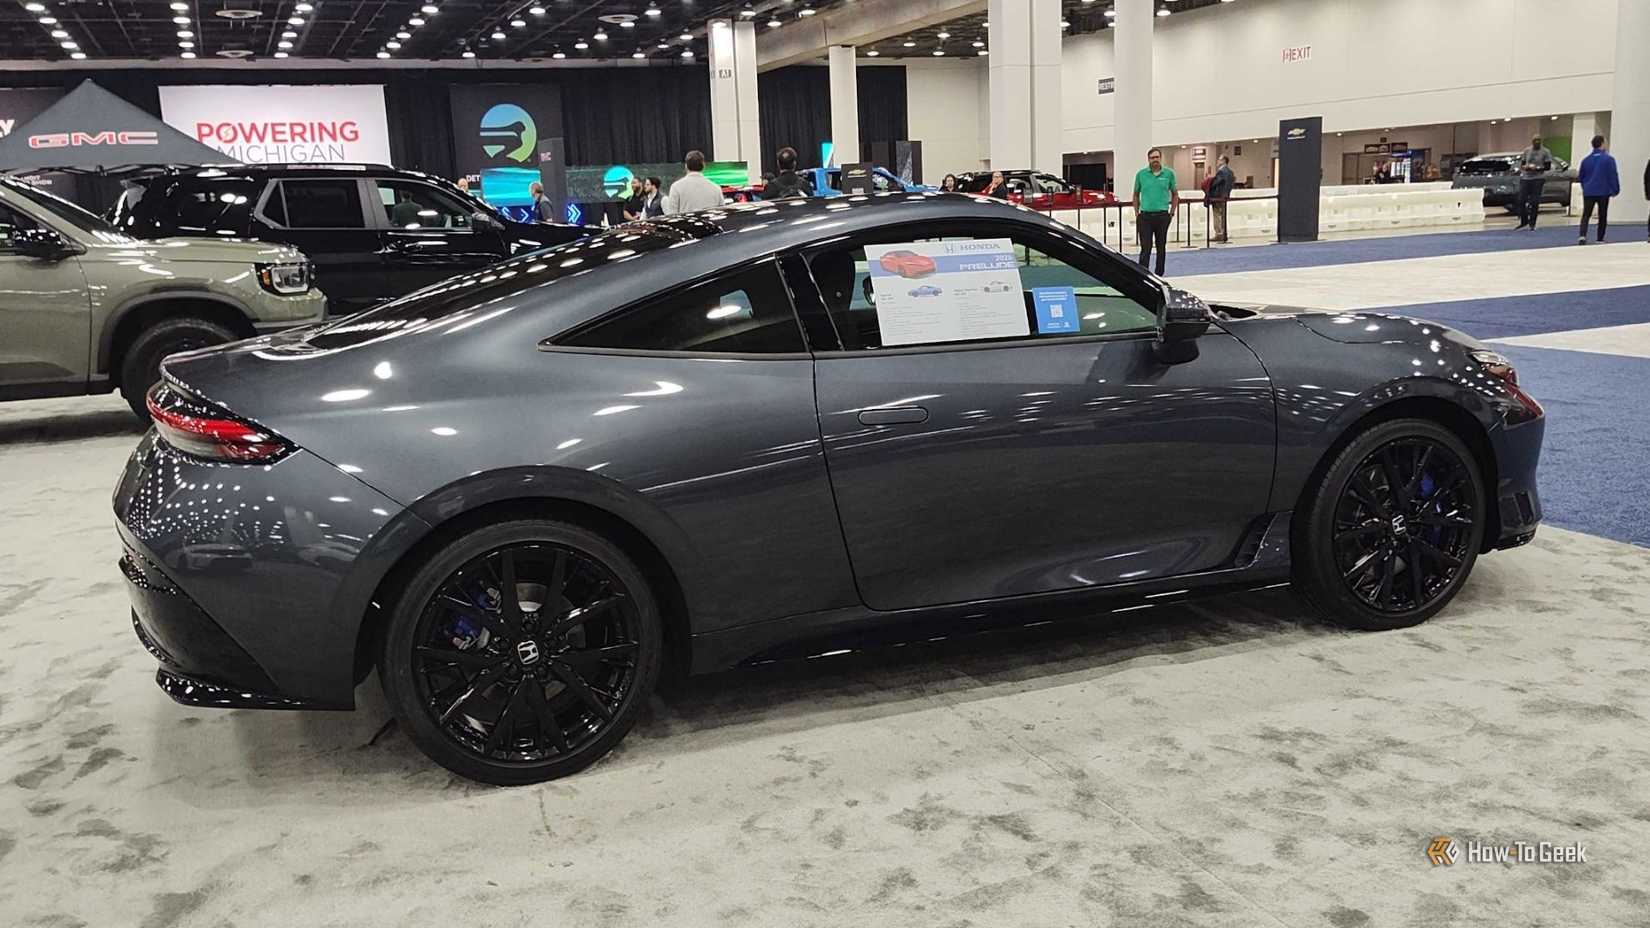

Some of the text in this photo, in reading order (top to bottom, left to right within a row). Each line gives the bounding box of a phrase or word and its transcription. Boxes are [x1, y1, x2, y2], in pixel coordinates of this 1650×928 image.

[1290, 46, 1311, 60] EXIT
[196, 121, 359, 144] POWERING
[28, 131, 158, 149] GMC
[960, 242, 1000, 250] HONDA
[960, 262, 1016, 271] PRELUDE
